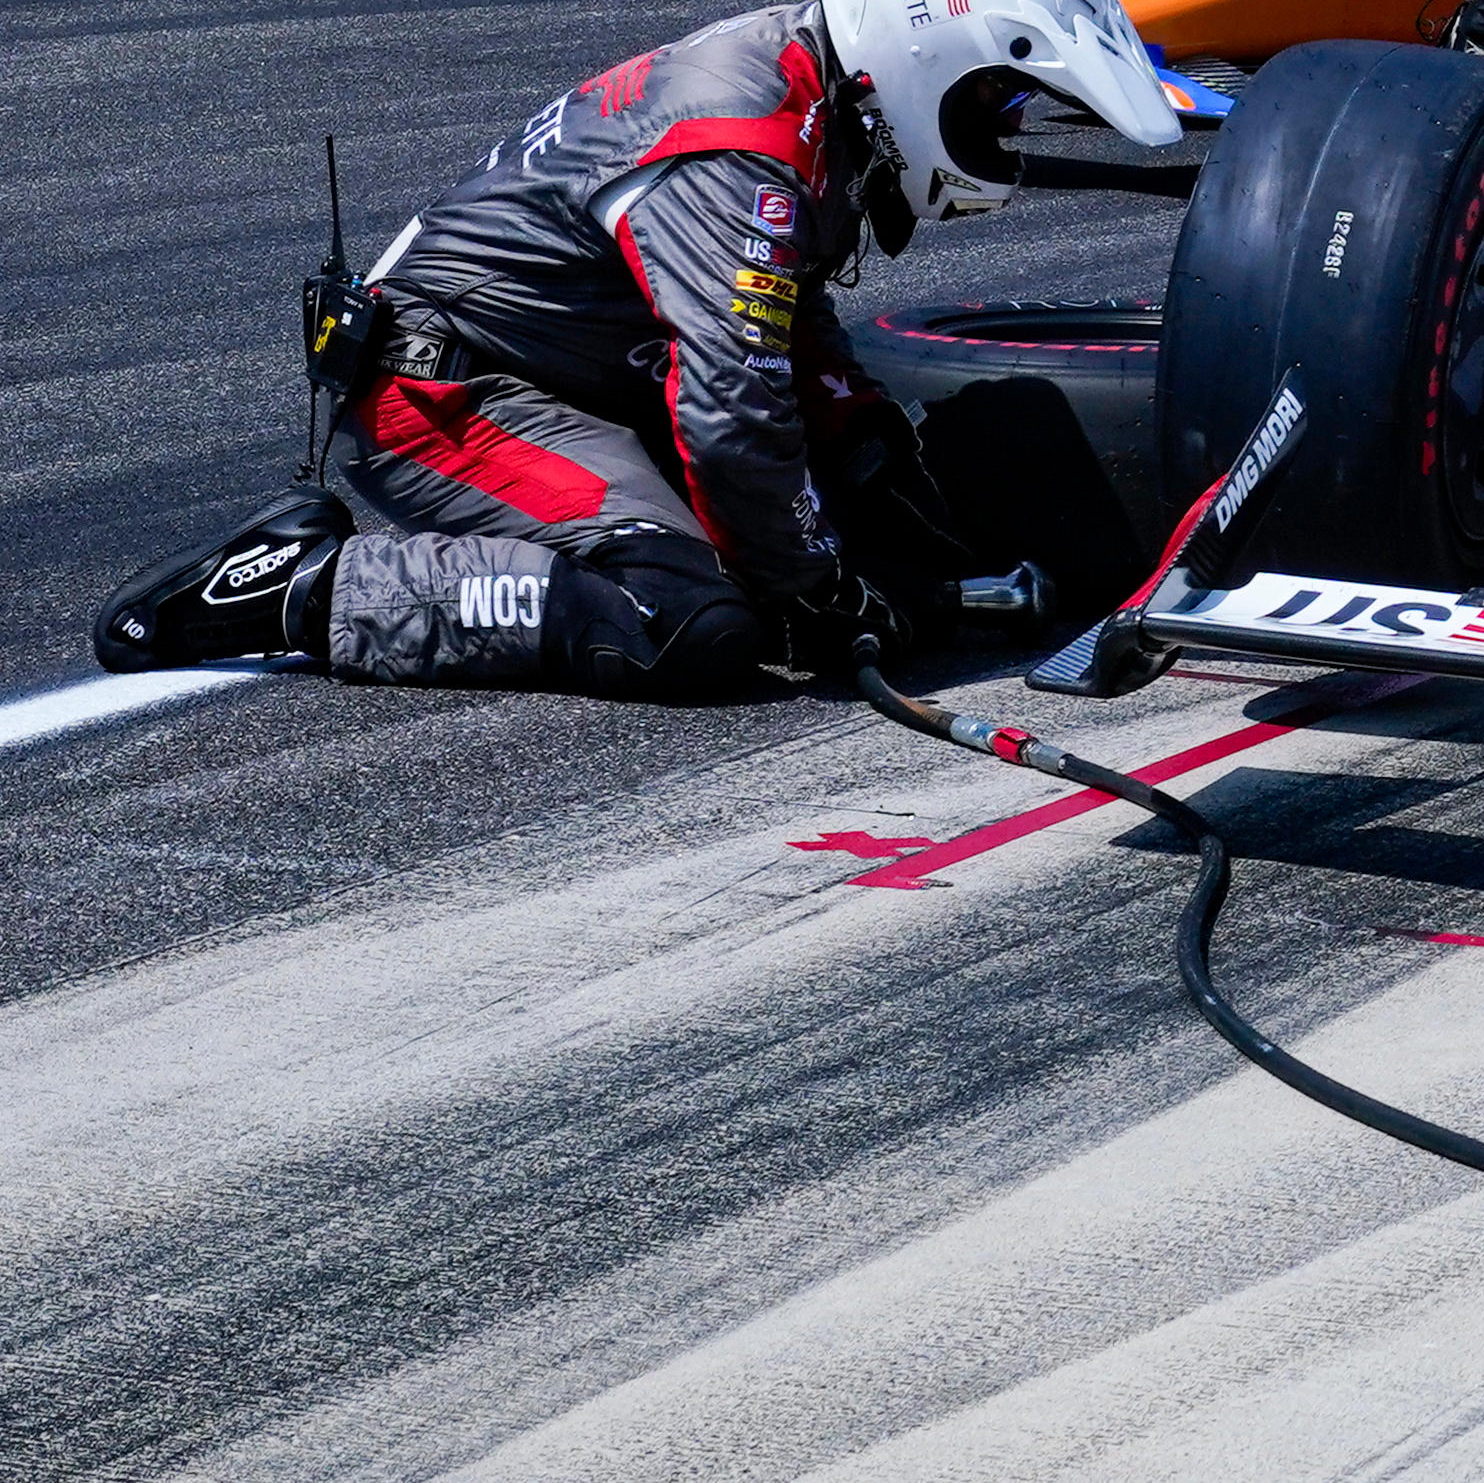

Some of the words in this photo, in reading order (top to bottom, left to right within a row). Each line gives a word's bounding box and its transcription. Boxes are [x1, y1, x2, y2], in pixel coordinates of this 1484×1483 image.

[744, 237, 771, 262] US
[751, 274, 796, 298] DHL
[1253, 387, 1303, 471] MORI
[1214, 454, 1259, 534] DMG
[1262, 588, 1455, 638] US
